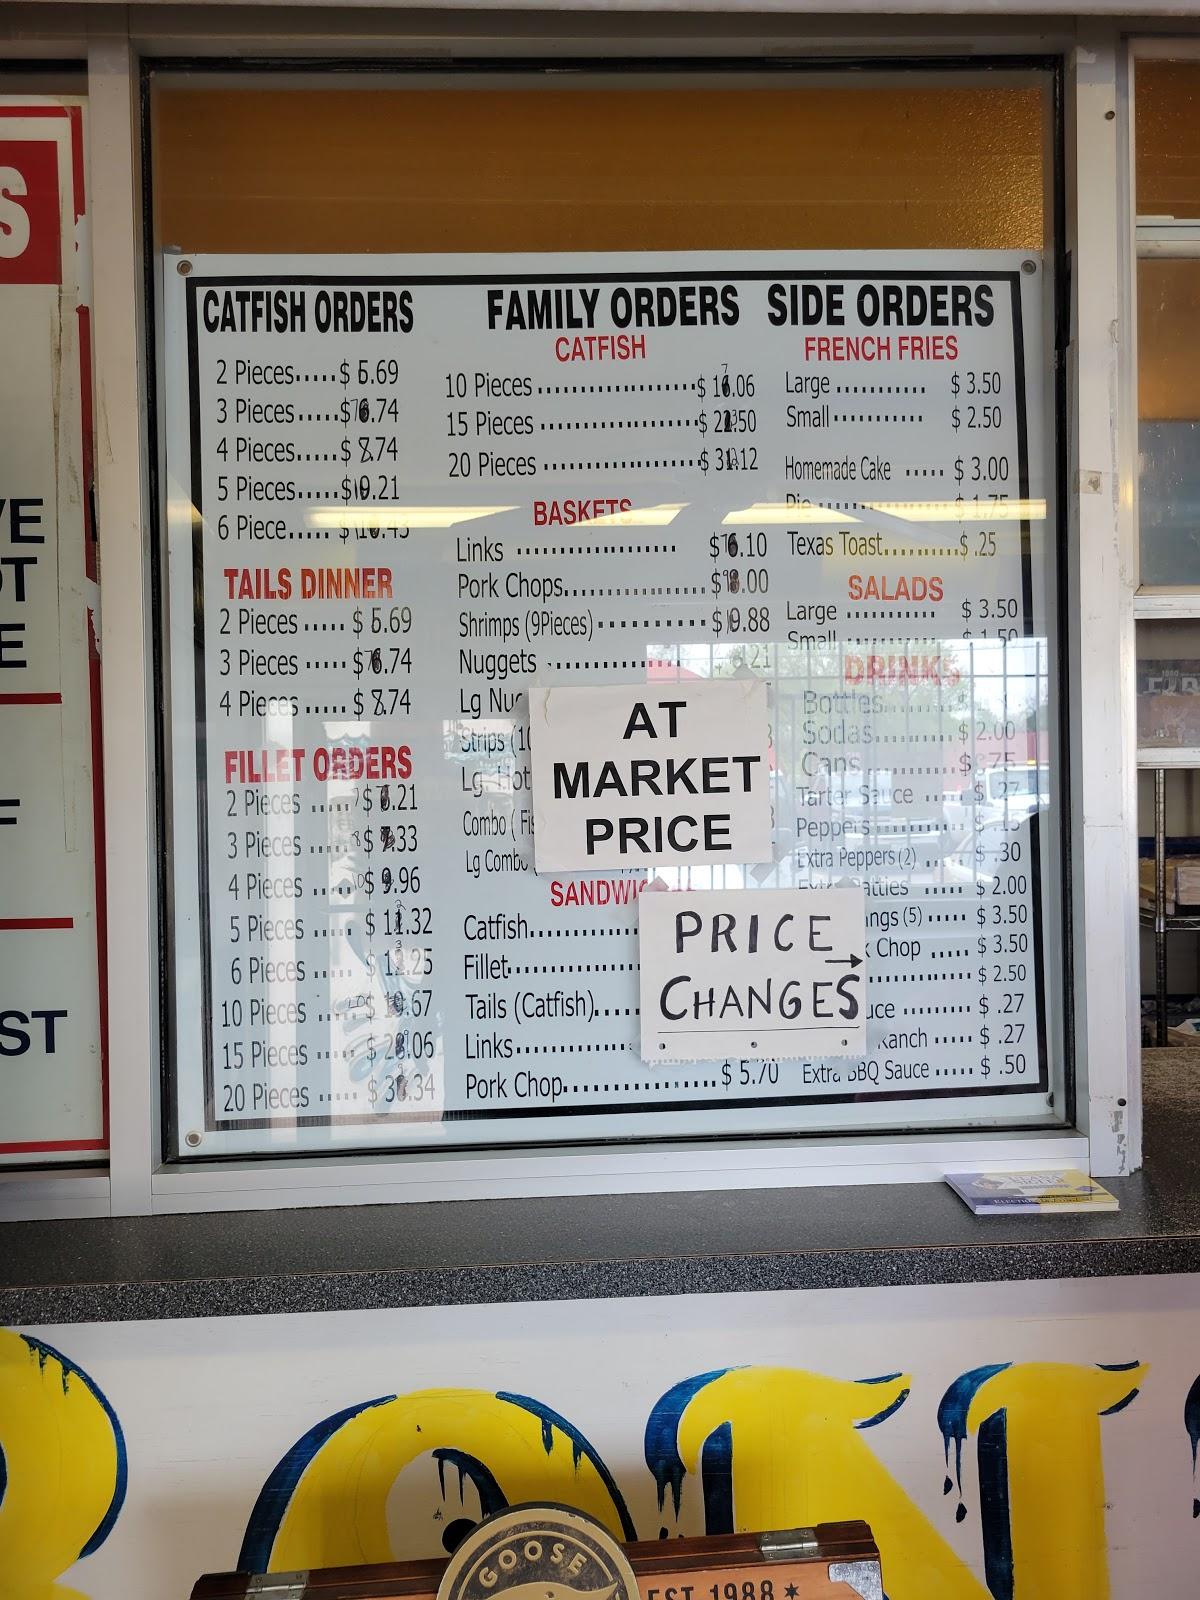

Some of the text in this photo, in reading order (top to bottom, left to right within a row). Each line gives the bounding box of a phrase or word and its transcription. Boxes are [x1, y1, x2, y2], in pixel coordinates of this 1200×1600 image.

[204, 290, 414, 333] CATFISH ORDERS
[486, 284, 740, 331] FAMILY ORDERS
[768, 283, 995, 327] SIDE ORDERS
[555, 334, 646, 362] CATFISH
[804, 335, 959, 361] FRENCH FRIES
[216, 360, 227, 384] 2
[445, 373, 467, 398] 10
[785, 371, 830, 399] Large
[216, 398, 227, 423] 3
[786, 404, 830, 428] Small
[447, 412, 468, 437] 15
[216, 437, 227, 462] 4
[448, 452, 471, 478] 20
[785, 455, 856, 481] Homemade
[860, 456, 891, 481] Cake
[218, 476, 228, 501] 5
[533, 498, 633, 527] BASKETS
[218, 515, 229, 540] 6
[456, 536, 504, 562] Links
[787, 531, 833, 556] Texas
[224, 567, 393, 600] TAILS DINNER
[458, 572, 498, 599] Pork
[848, 575, 944, 601] SALADS
[220, 608, 298, 635] 2 Pieces
[786, 600, 837, 625] Large
[459, 611, 520, 643] Shrimps
[787, 630, 837, 651] Small
[220, 649, 298, 676] 3 Pieces
[459, 648, 537, 680] Nuggets
[844, 655, 961, 687] DRINKS
[219, 690, 231, 717] 4
[239, 690, 298, 717] Pieces
[460, 688, 481, 719] Lg
[622, 701, 687, 740] AT
[461, 727, 505, 758] Strips
[224, 745, 413, 784] FILLET ORDERS
[553, 756, 761, 799] MARKET
[226, 790, 237, 816] 2
[245, 789, 300, 816] Pieces
[796, 786, 851, 807] Tarter
[859, 784, 913, 804] Sauce
[463, 810, 506, 836] Combo
[586, 814, 732, 855] PRICE
[796, 817, 871, 841] Peppers
[227, 832, 238, 859] 3
[246, 831, 301, 858] Pieces
[466, 850, 480, 878] Lg
[798, 848, 833, 868] Extra
[840, 847, 896, 871] Peppers
[228, 873, 240, 901] 4
[246, 872, 303, 900] Pieces
[230, 915, 240, 943] 5
[248, 914, 304, 942] Pieces
[675, 910, 833, 954] PRICE
[876, 937, 921, 961] Chop
[231, 957, 242, 984] 6
[249, 956, 305, 984] Pieces
[465, 994, 507, 1020] Tails
[659, 974, 861, 1022] CHANGES
[221, 999, 242, 1027] 10
[250, 998, 307, 1026] Pieces
[223, 1040, 308, 1070] 15 Pieces
[885, 1060, 929, 1080] Sauce
[223, 1084, 245, 1112] 20
[252, 1083, 309, 1110] Pieces
[466, 1073, 507, 1099] Pork
[479, 1540, 587, 1588] GOOSE
